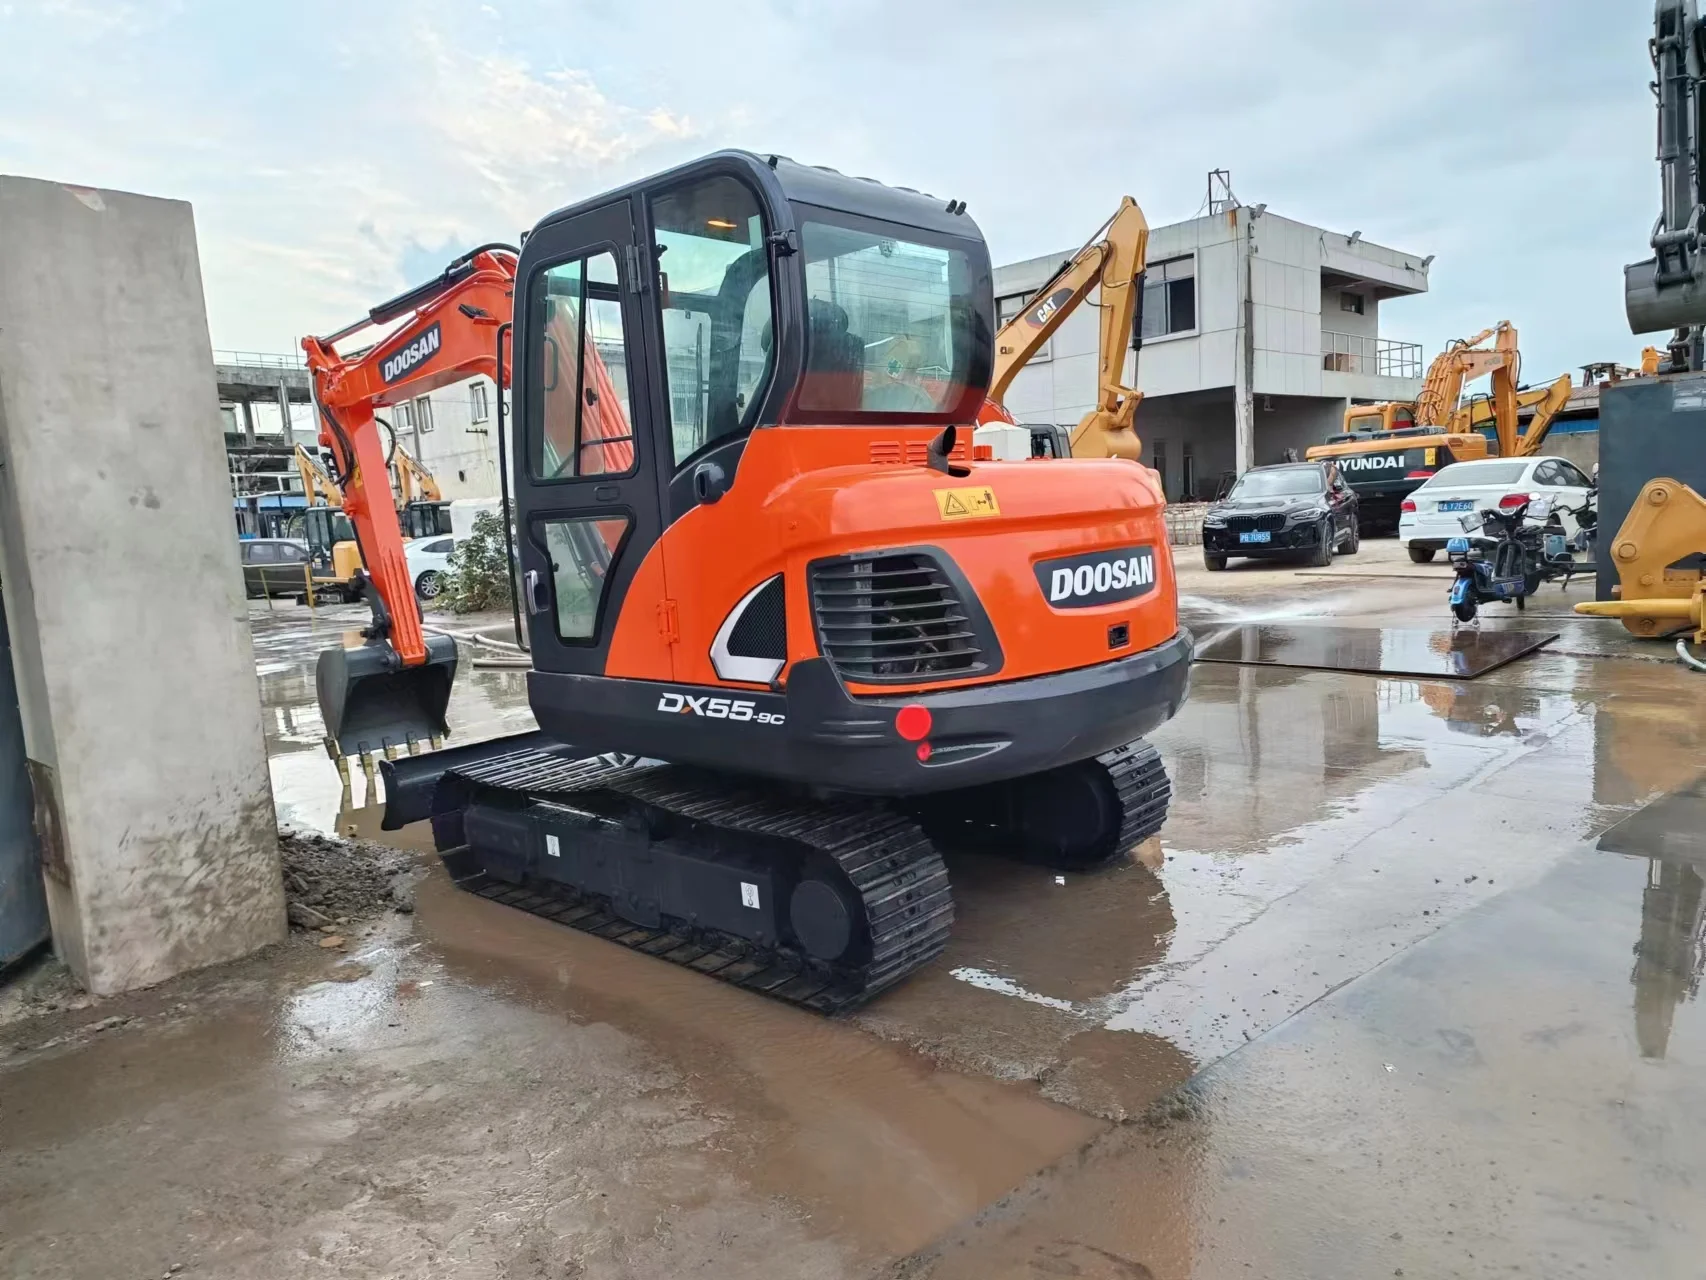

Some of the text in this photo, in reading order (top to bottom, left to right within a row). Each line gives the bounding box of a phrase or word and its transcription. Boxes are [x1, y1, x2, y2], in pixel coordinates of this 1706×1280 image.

[1037, 296, 1057, 323] CAT
[384, 328, 440, 383] DOOSAN
[1050, 555, 1153, 602] DOOSAN
[657, 692, 786, 725] DX55-9C
